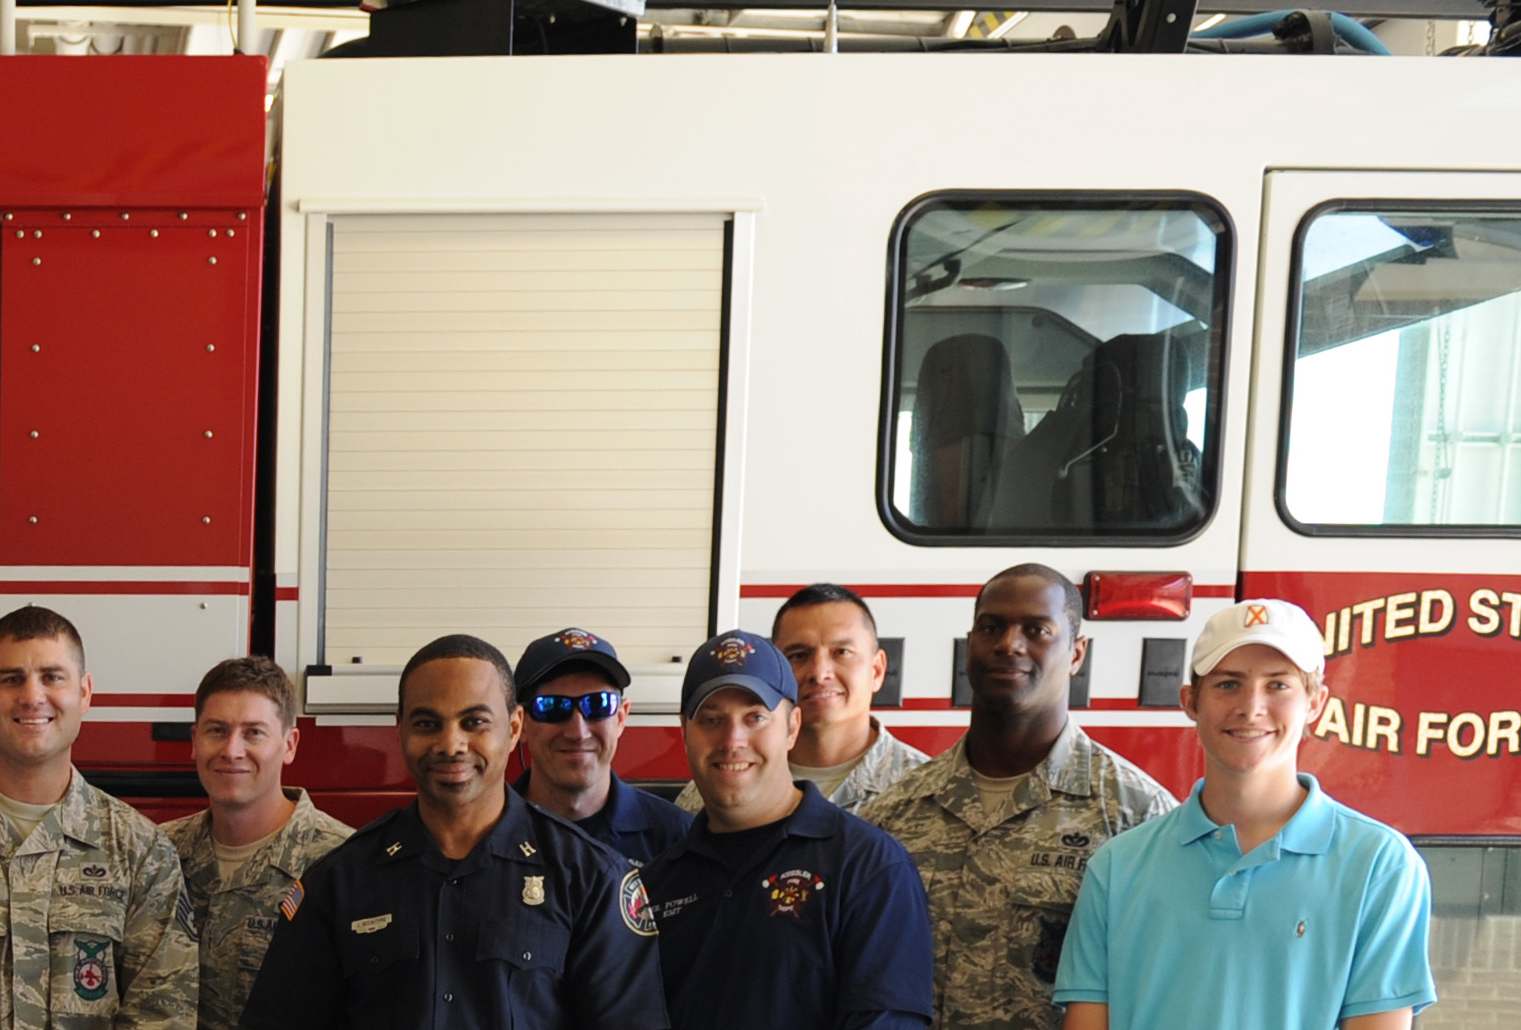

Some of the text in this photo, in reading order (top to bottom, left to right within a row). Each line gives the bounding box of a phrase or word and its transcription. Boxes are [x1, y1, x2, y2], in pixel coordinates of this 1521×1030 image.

[1314, 696, 1402, 755] AIR
[1030, 853, 1051, 867] U.S.
[1054, 855, 1075, 870] AIR
[59, 884, 127, 900] U.S. AIR FORCE
[664, 894, 698, 910] POWELL
[663, 907, 682, 918] EMT
